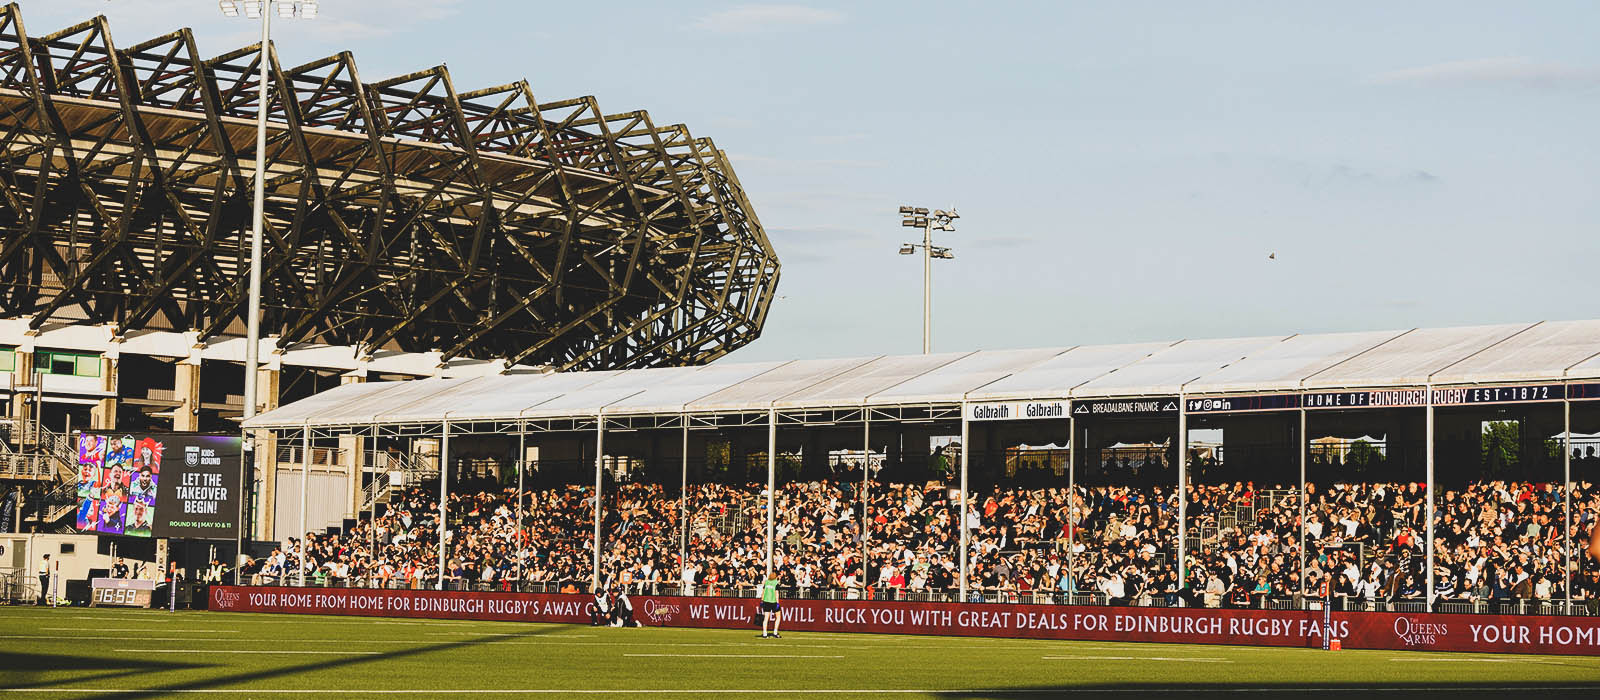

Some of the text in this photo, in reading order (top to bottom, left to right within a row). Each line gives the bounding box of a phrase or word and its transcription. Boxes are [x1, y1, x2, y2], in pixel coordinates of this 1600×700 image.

[1308, 393, 1342, 406] HOME
[1350, 393, 1365, 406] OF
[1369, 391, 1426, 406] EDINBURGH
[1433, 389, 1468, 404] RUGBY
[973, 404, 1009, 419] Galbraith
[1026, 402, 1063, 417] Galbraith
[1092, 401, 1160, 413] BREADALBANE FINANCE
[200, 449, 215, 457] KIDS
[200, 457, 221, 465] ROUND
[182, 472, 222, 487] LET THE
[175, 486, 228, 501] TAKEOVER
[184, 500, 218, 514] BEGIN!
[248, 593, 277, 607] YOUR
[280, 594, 312, 607] HOME
[315, 595, 346, 609] FROM
[350, 596, 384, 610] HOME
[387, 597, 411, 611] FOR
[414, 598, 484, 613] EDINBURGH
[543, 601, 582, 616] AWAY
[689, 604, 710, 620] WE
[714, 605, 751, 624] WILL,
[781, 606, 815, 623] WILL
[825, 607, 867, 624] RUCK
[870, 608, 905, 625] YOU
[909, 609, 952, 626] WITH
[957, 611, 1011, 628] GREAT
[1016, 612, 1068, 630] DEALS
[1074, 614, 1109, 632] FOR
[1114, 615, 1222, 635] EDINBURGH
[1229, 617, 1293, 637] RUGBY
[1299, 619, 1349, 638] FANS
[1394, 616, 1448, 638] QUEENS
[1405, 634, 1436, 646] ARMS
[1469, 624, 1531, 644] YOUR
